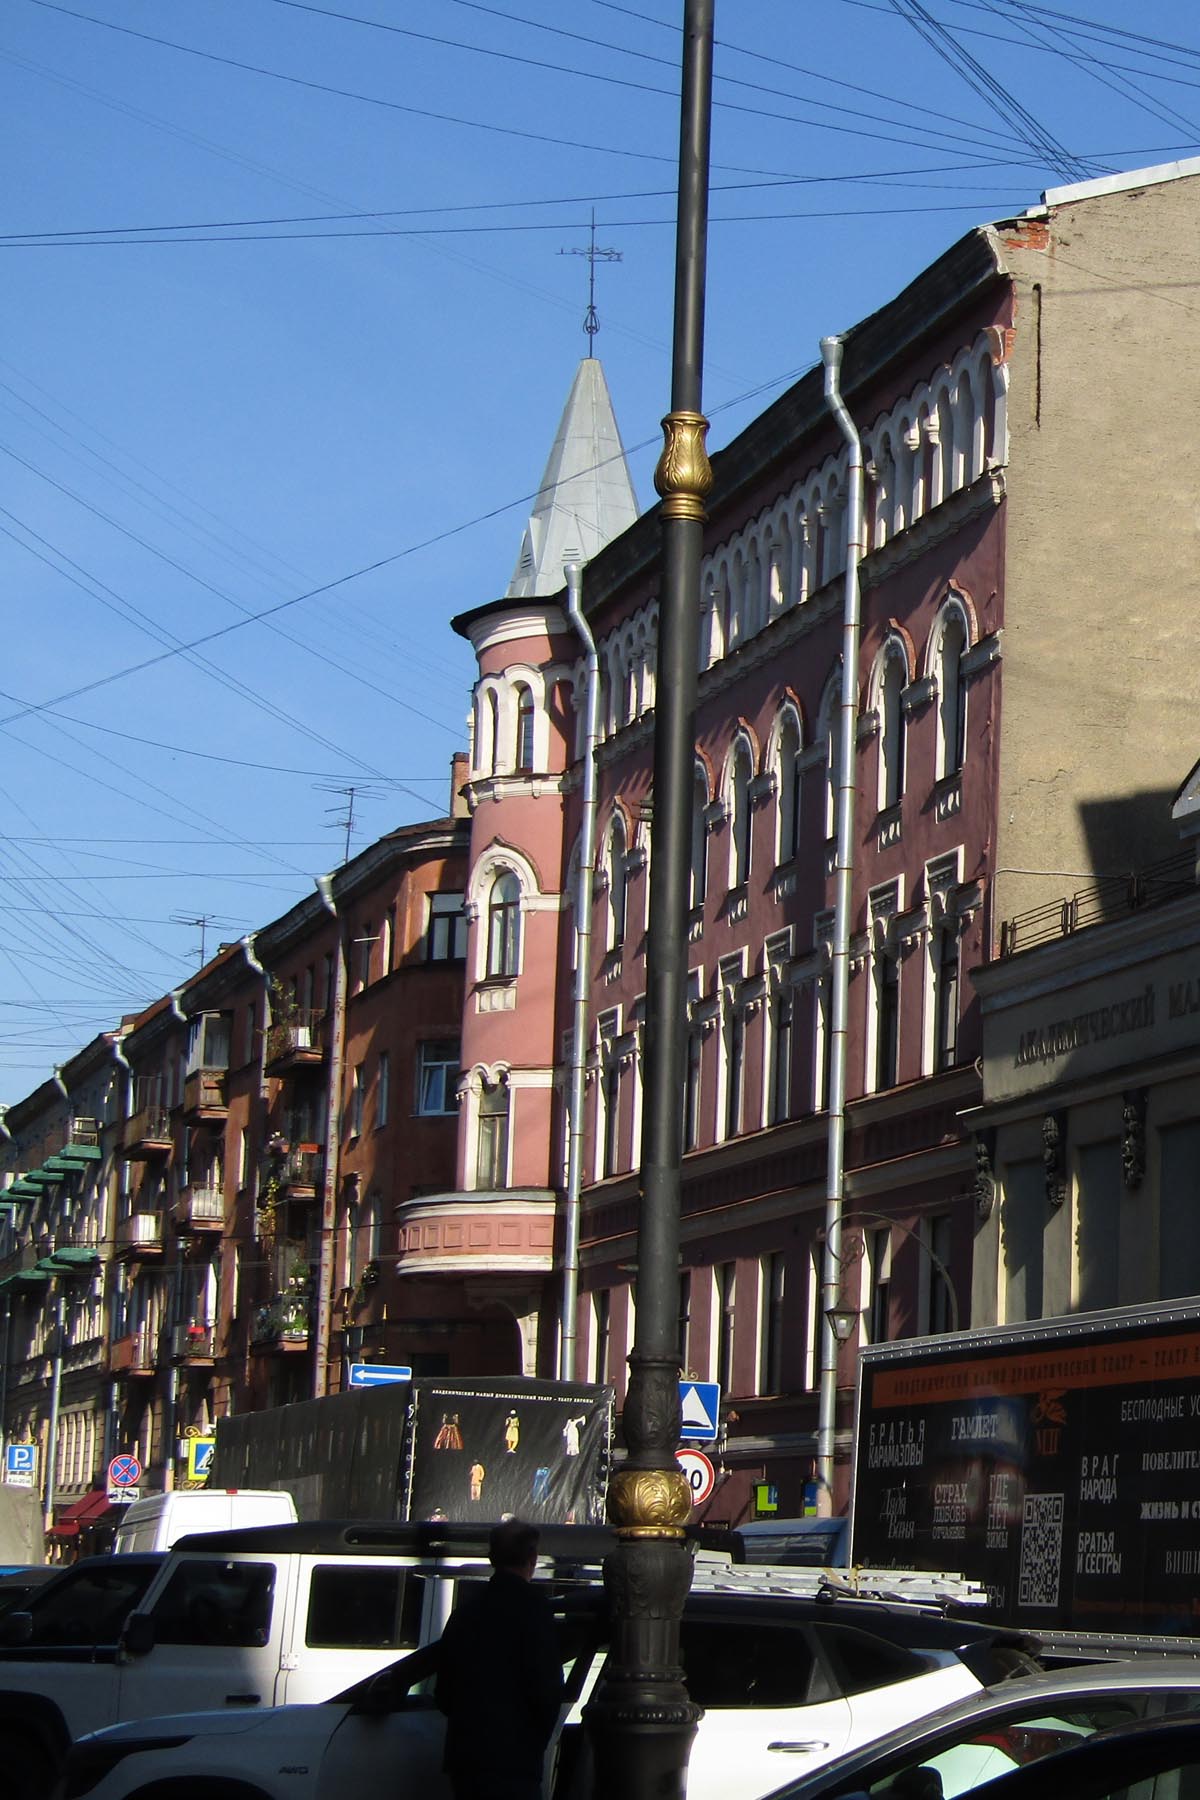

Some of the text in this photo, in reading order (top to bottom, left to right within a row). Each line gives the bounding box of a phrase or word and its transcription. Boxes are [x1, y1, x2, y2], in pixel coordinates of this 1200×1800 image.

[1103, 1354, 1134, 1373] ТЕАТР
[1154, 1347, 1188, 1367] ТЕАТР
[1121, 1396, 1185, 1423] БЕСПЛОДНЫЕ
[870, 1419, 925, 1446] БРАТЬЯ
[951, 1415, 999, 1440] ГАМЛЕТ
[868, 1443, 924, 1469] КАРАМАЗОВЫ
[1082, 1454, 1119, 1477] ВРАГ
[934, 1483, 968, 1504] СТРАХ
[989, 1474, 1009, 1501] ГДЕ
[1080, 1478, 1117, 1503] НАРОДА
[1140, 1501, 1179, 1520] ЖИЗНЬ
[1181, 1501, 1189, 1519] И
[1078, 1532, 1115, 1553] БРАТЬЯ
[1085, 1553, 1122, 1574] СЕСТРЫ
